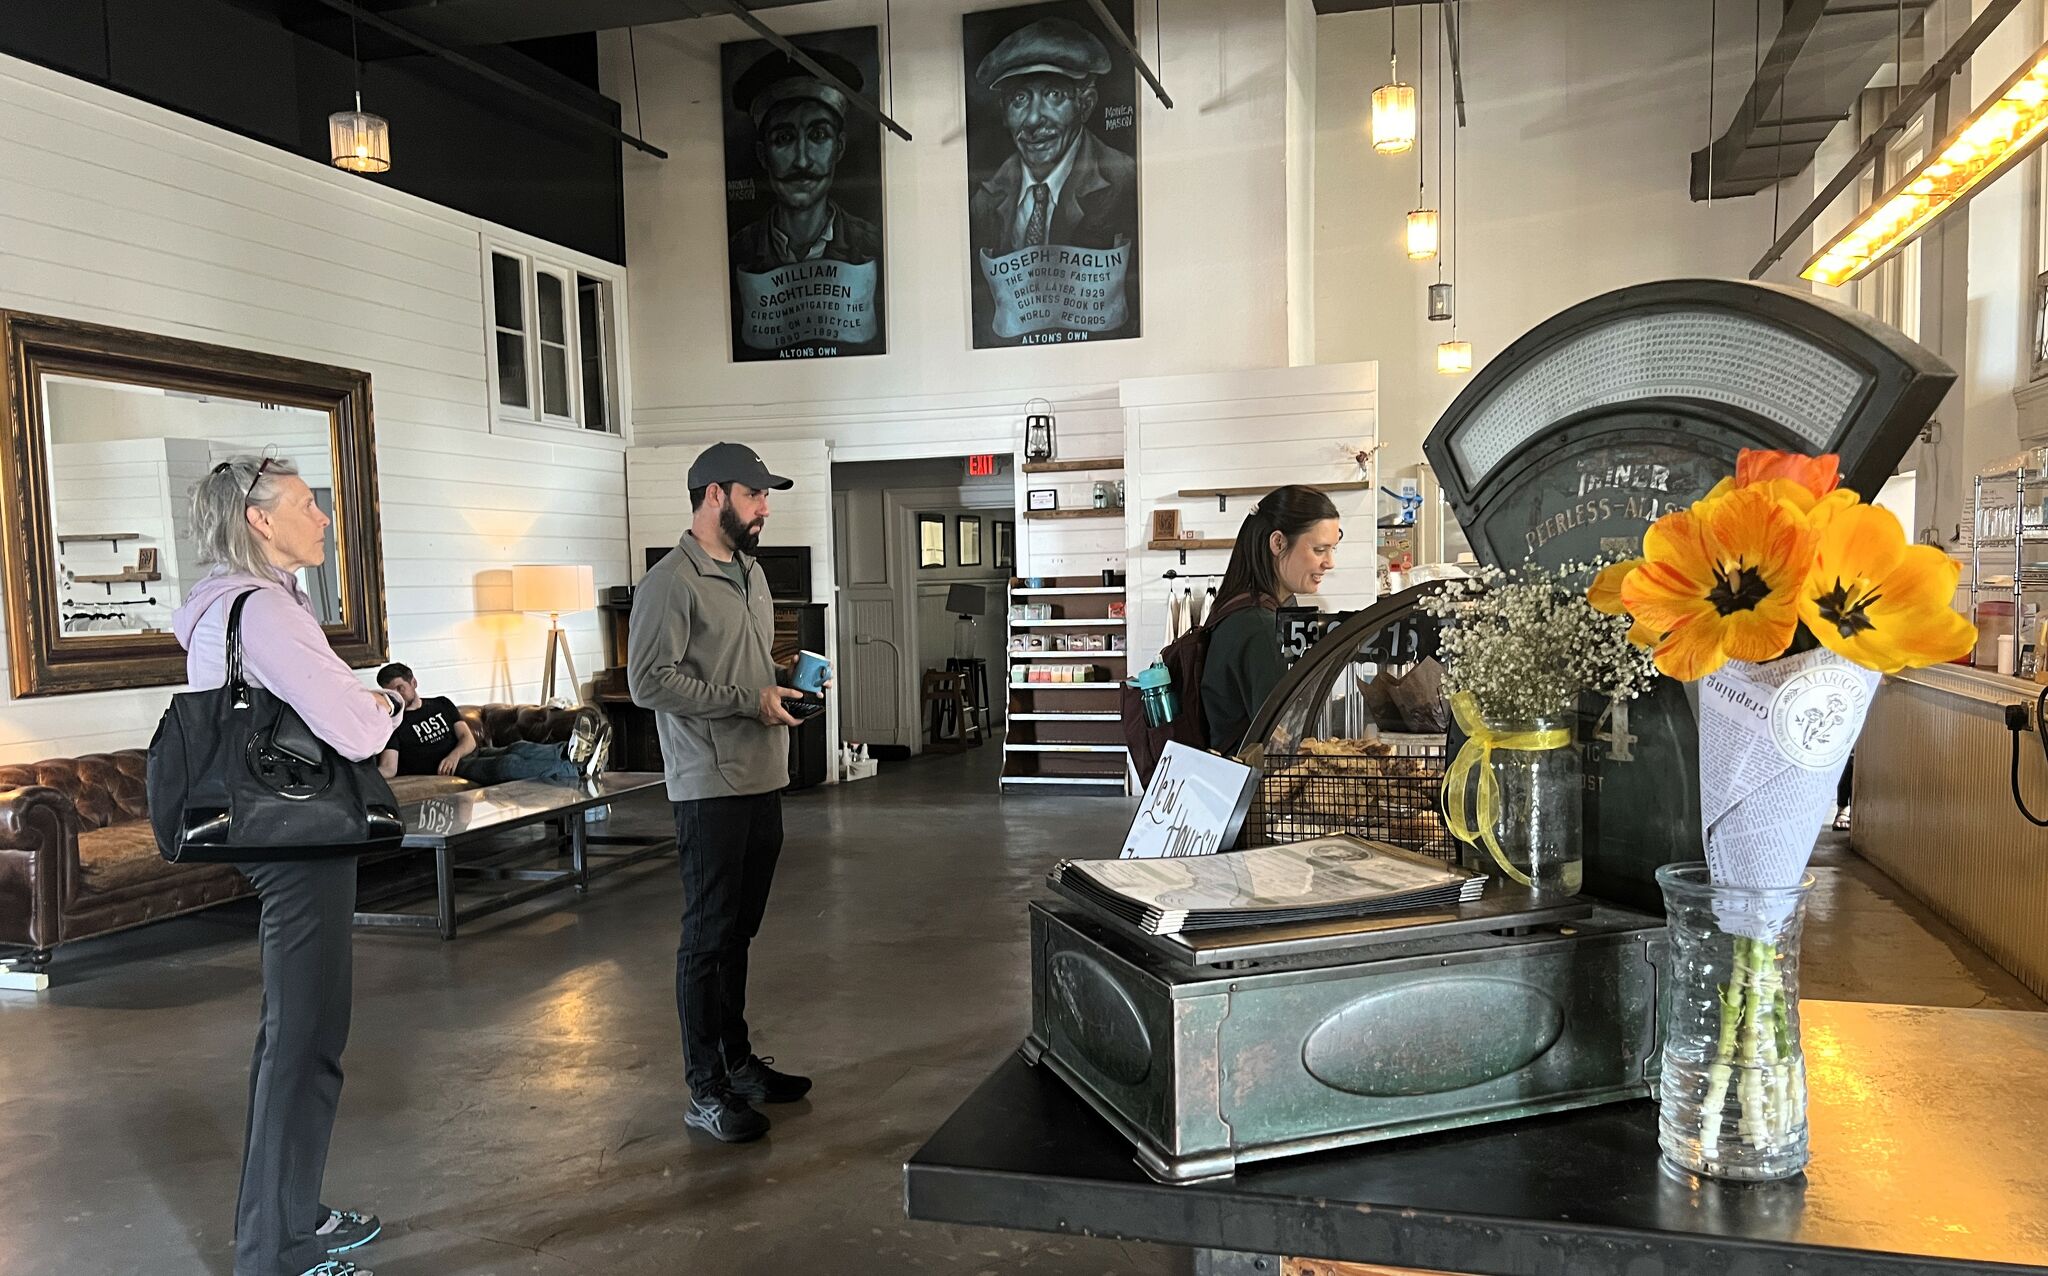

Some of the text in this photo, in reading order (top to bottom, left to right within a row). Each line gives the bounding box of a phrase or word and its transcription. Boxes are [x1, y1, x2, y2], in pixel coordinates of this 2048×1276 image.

[990, 250, 1122, 277] JOSEPH RAGLIN
[771, 265, 838, 287] WILLIAM
[1005, 267, 1111, 286] THE WORLDS FASTEST
[760, 284, 851, 307] SACHTLEBEN
[1014, 283, 1040, 299] BRICK
[1080, 288, 1105, 298] 1929
[751, 300, 865, 320] CIRCUMNAVIGATED THE
[1018, 295, 1105, 311] GUINESS BOOK OF
[752, 315, 861, 335] GLOBE ON A BICYCLE
[1019, 309, 1106, 325] WORLD RECORDS
[1022, 332, 1088, 344] ALTON'S OWN
[780, 347, 837, 359] ALTON'S OWN
[970, 455, 994, 475] EXIT
[1706, 675, 1769, 720] Graphing
[412, 712, 447, 738] POST
